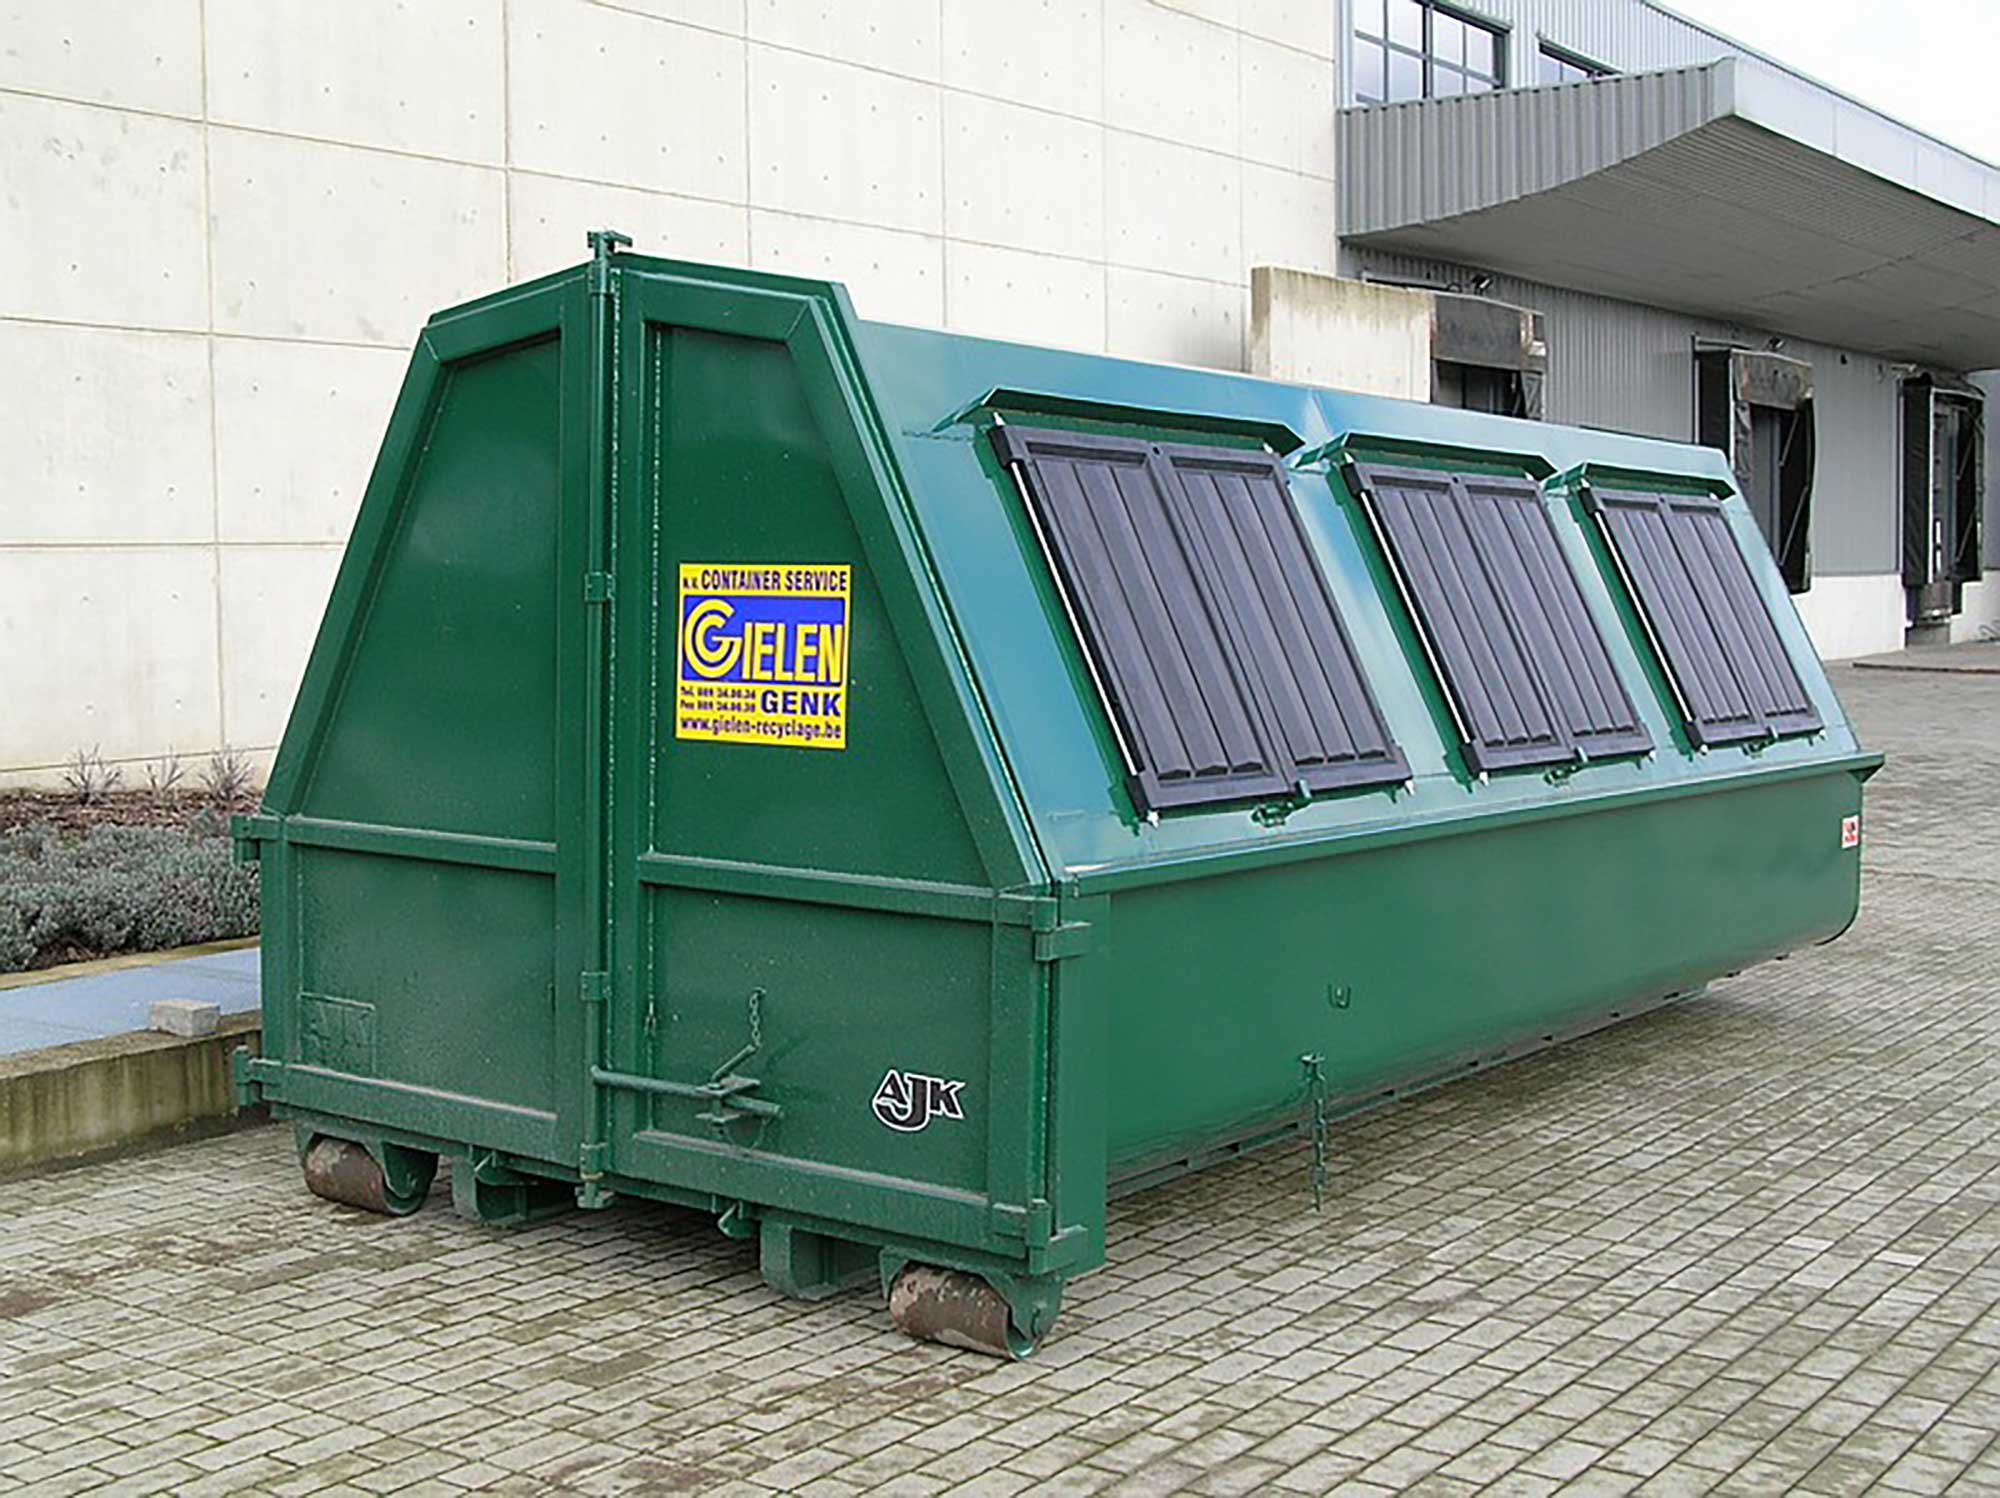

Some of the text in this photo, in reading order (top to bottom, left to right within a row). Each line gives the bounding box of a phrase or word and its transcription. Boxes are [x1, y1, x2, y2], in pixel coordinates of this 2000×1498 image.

[701, 569, 781, 591] CONTAINER
[784, 570, 847, 592] SERVICE
[684, 598, 843, 683] GIELEN
[760, 690, 842, 717] GENK
[681, 716, 842, 741] www.gielen-recyclage.be
[872, 1069, 966, 1132] AJK
